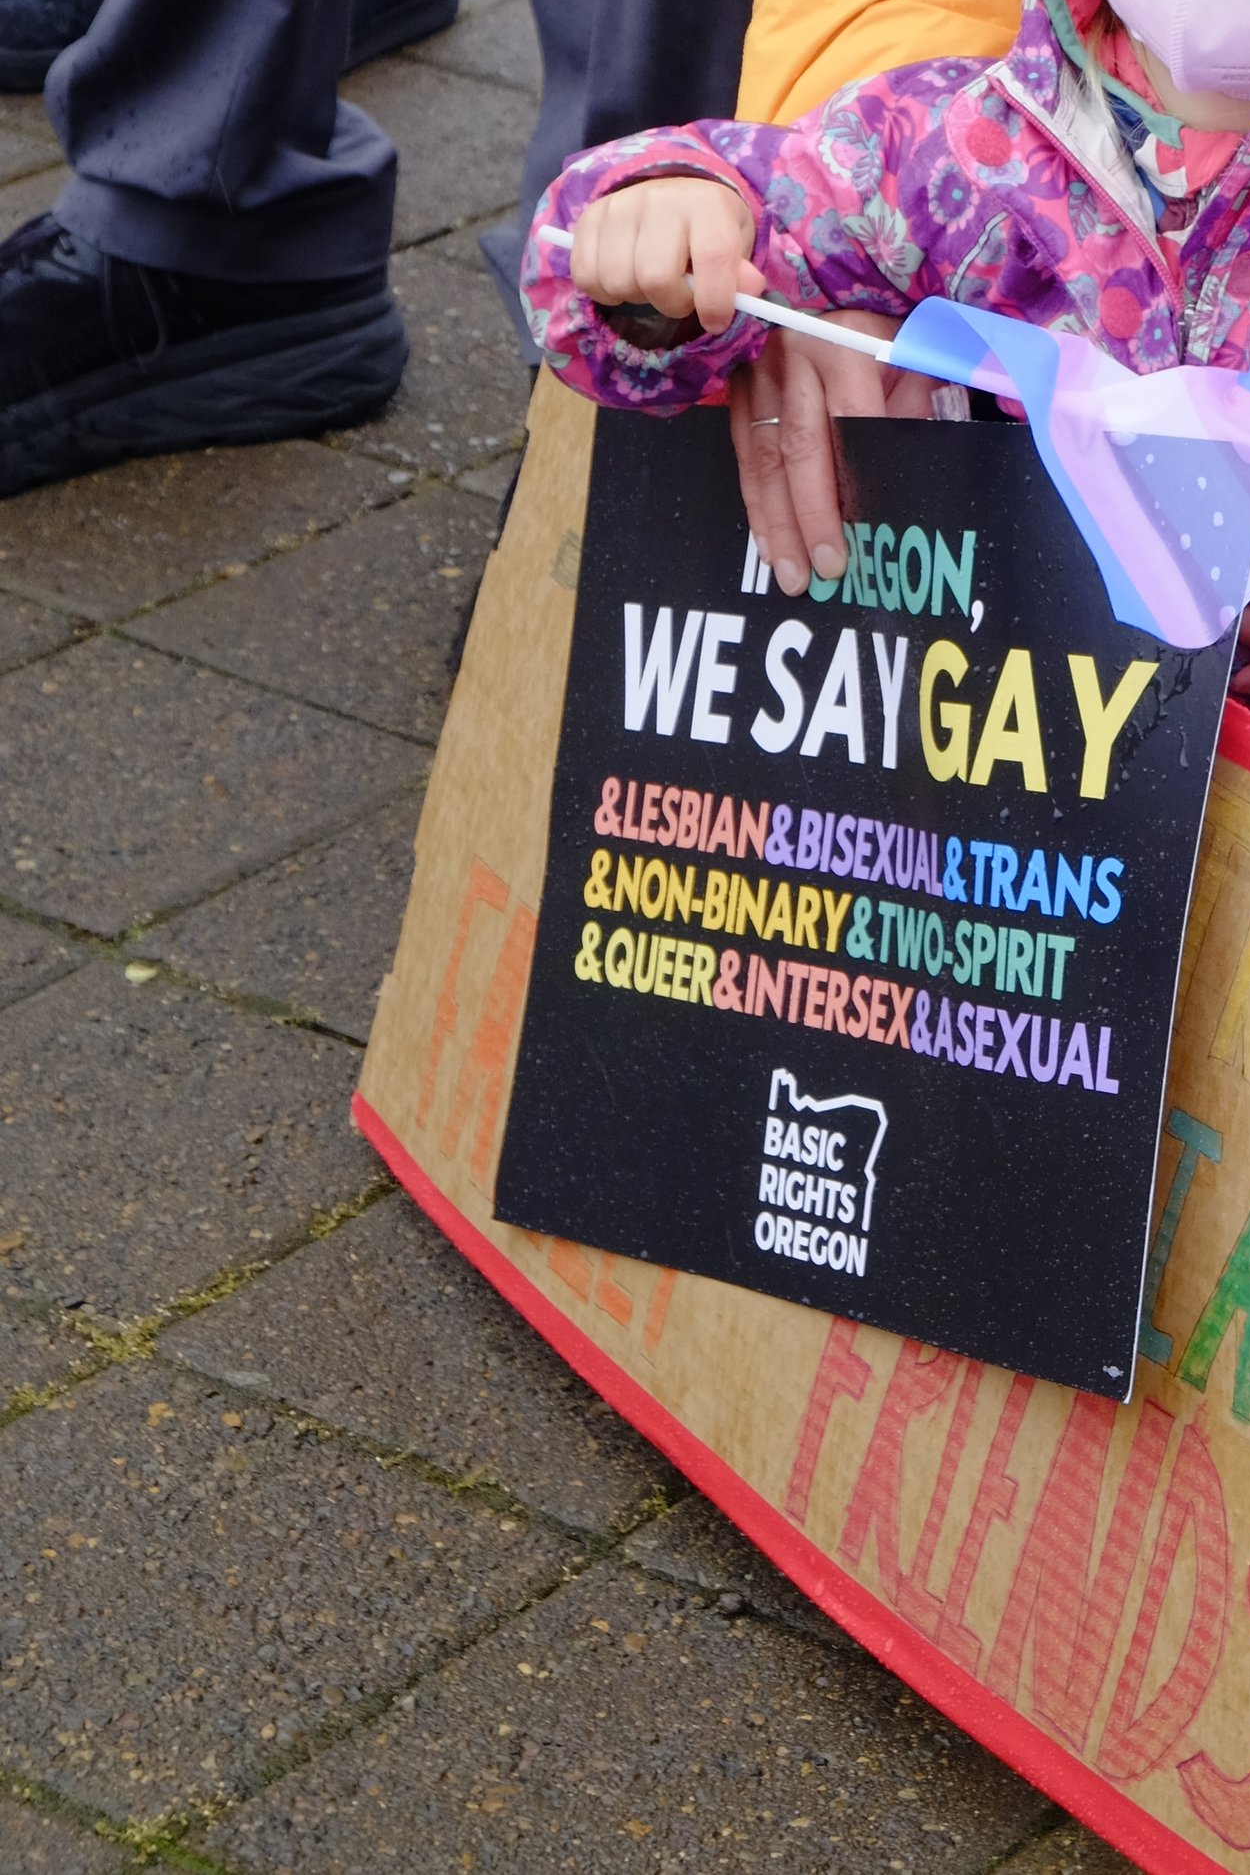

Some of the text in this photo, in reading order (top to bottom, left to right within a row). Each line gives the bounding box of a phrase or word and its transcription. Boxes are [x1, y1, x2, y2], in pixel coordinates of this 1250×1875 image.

[624, 603, 1159, 800] WE SAY GAY
[763, 1116, 847, 1172] BASIC
[758, 1163, 857, 1223] RIGHTS
[754, 1211, 868, 1278] OREGON
